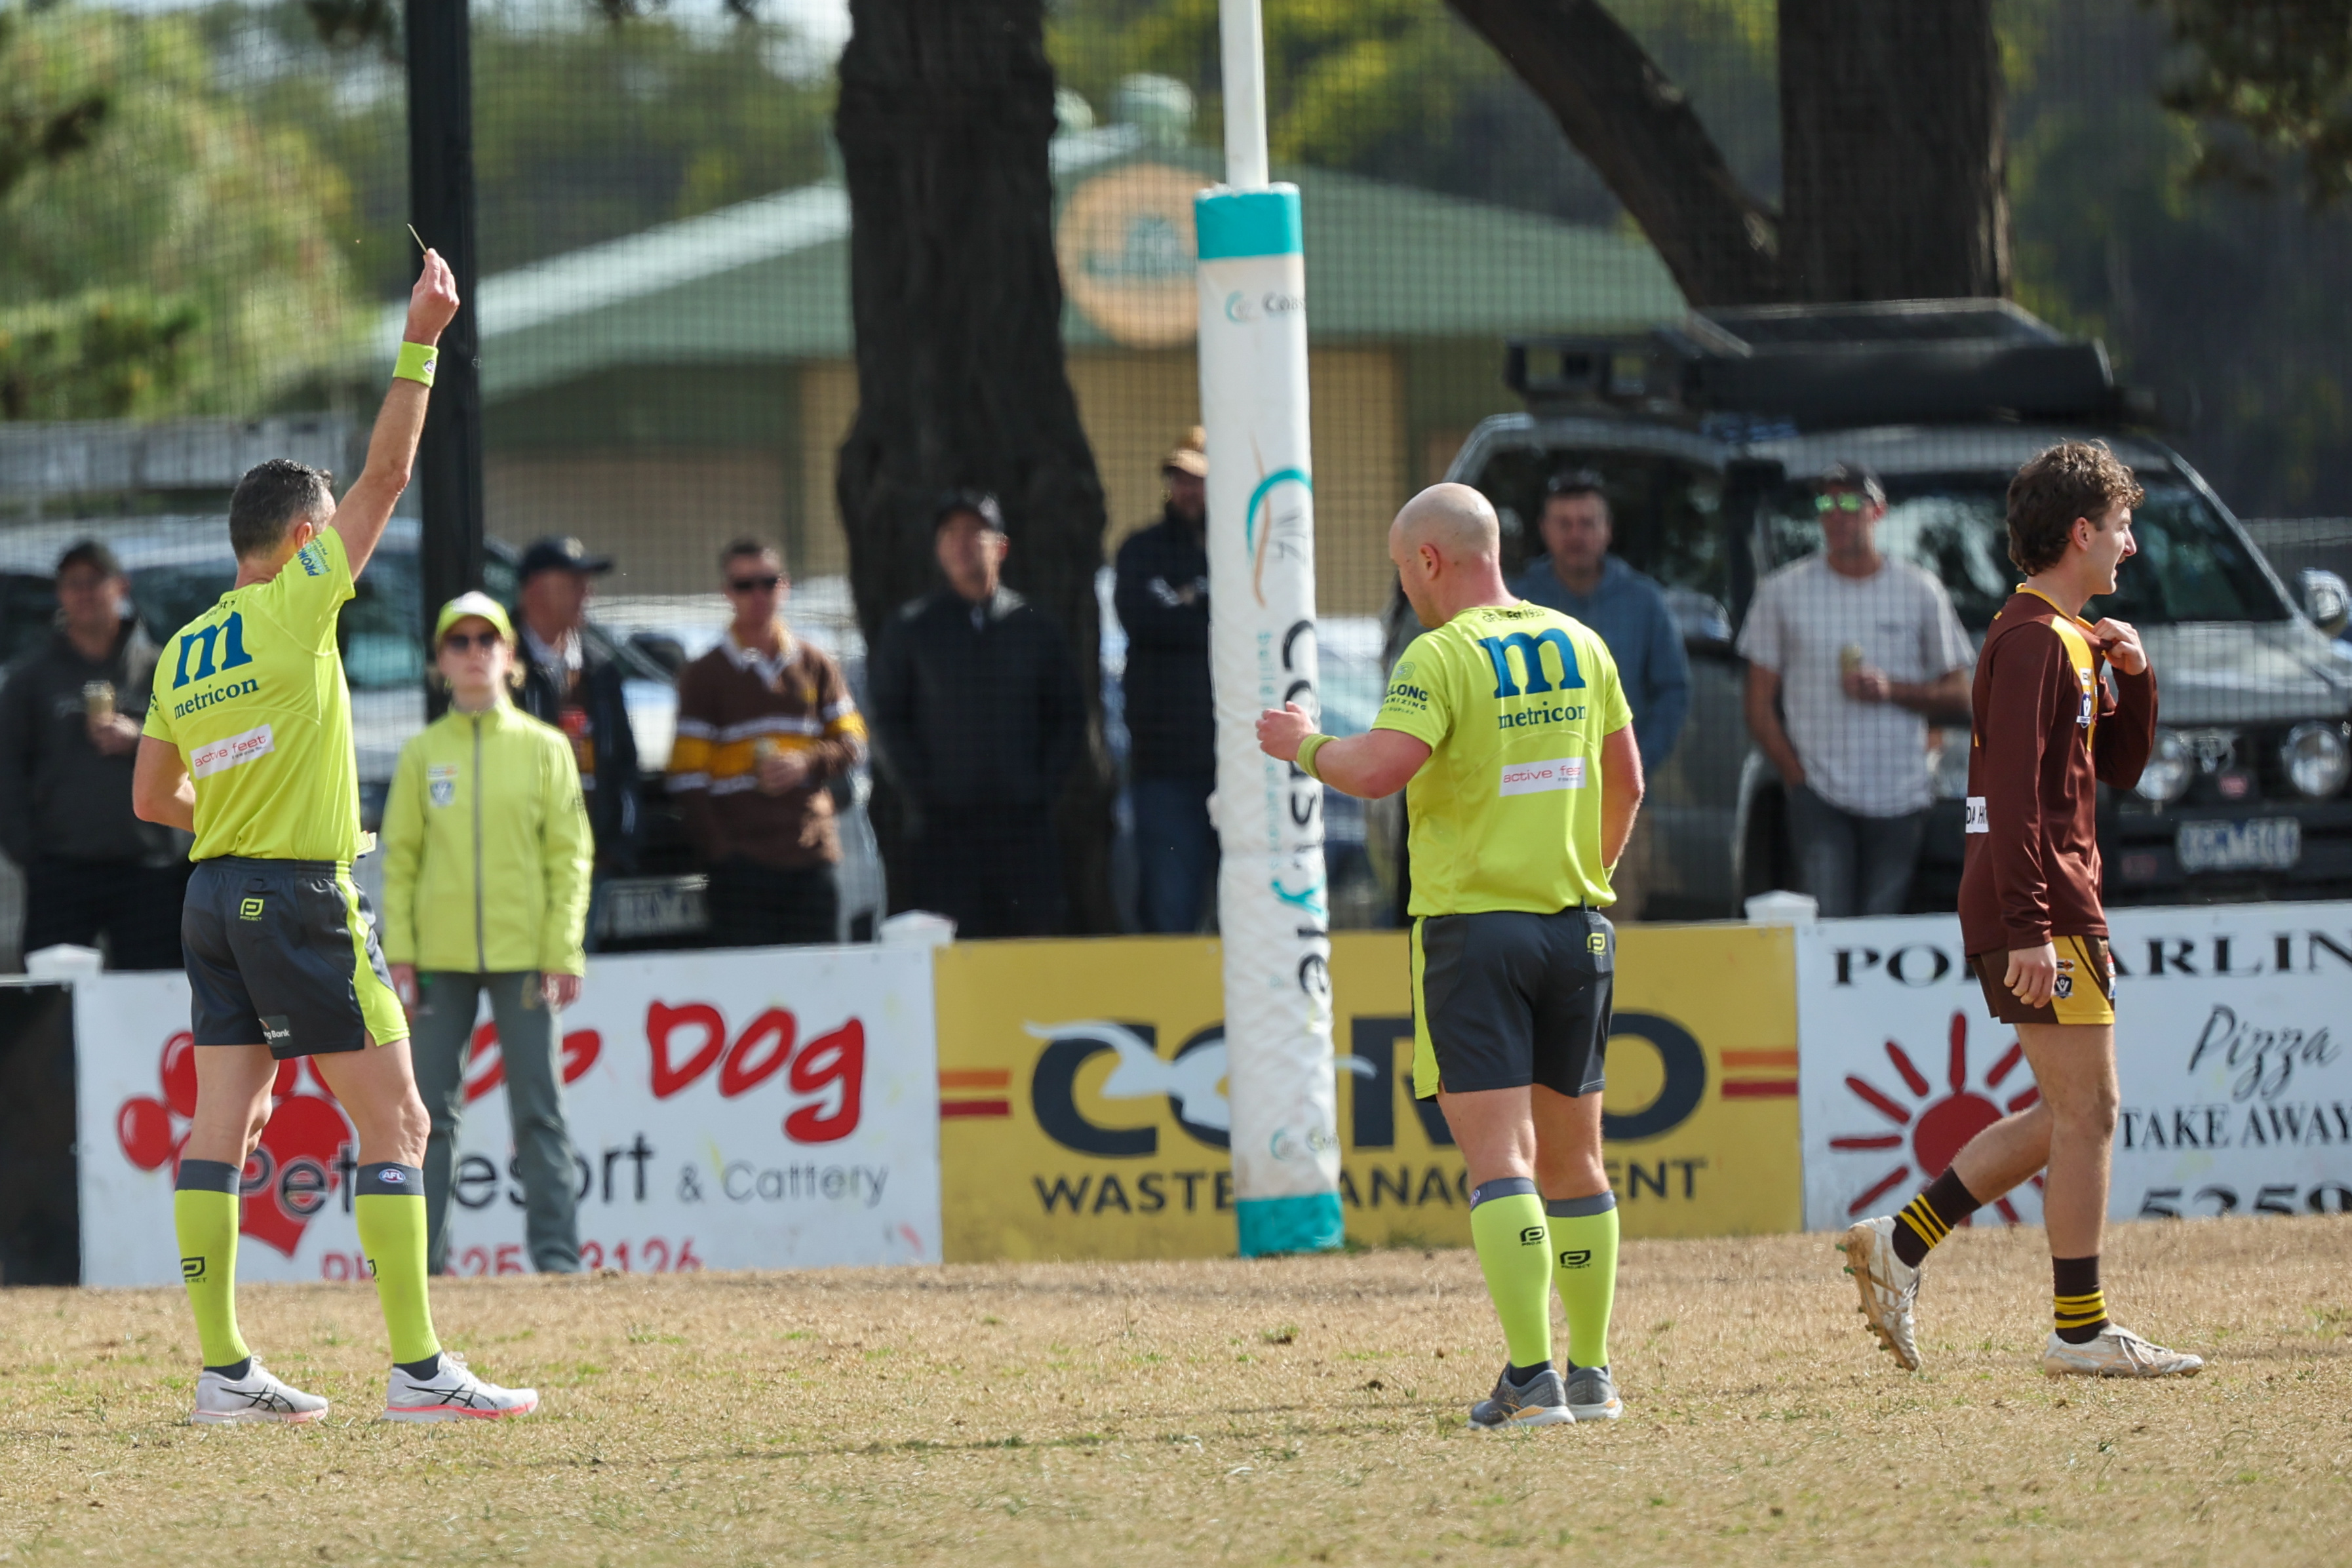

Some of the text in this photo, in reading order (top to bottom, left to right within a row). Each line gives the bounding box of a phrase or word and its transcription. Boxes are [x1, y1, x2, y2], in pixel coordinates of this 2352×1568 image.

[173, 678, 260, 720] metricon
[1498, 701, 1586, 730] metricon
[194, 749, 228, 767] actve
[231, 735, 266, 753] feet
[1503, 770, 1553, 783] active
[1832, 929, 2352, 986] PORLIN
[271, 1029, 290, 1038] Bank
[2188, 1004, 2342, 1102] Pizza
[2121, 1099, 2352, 1149] TAKE AWAY
[239, 1130, 889, 1219] Pet esrt & Cattery
[382, 1171, 404, 1180] AFL
[1337, 1159, 1708, 1210] ANAENT
